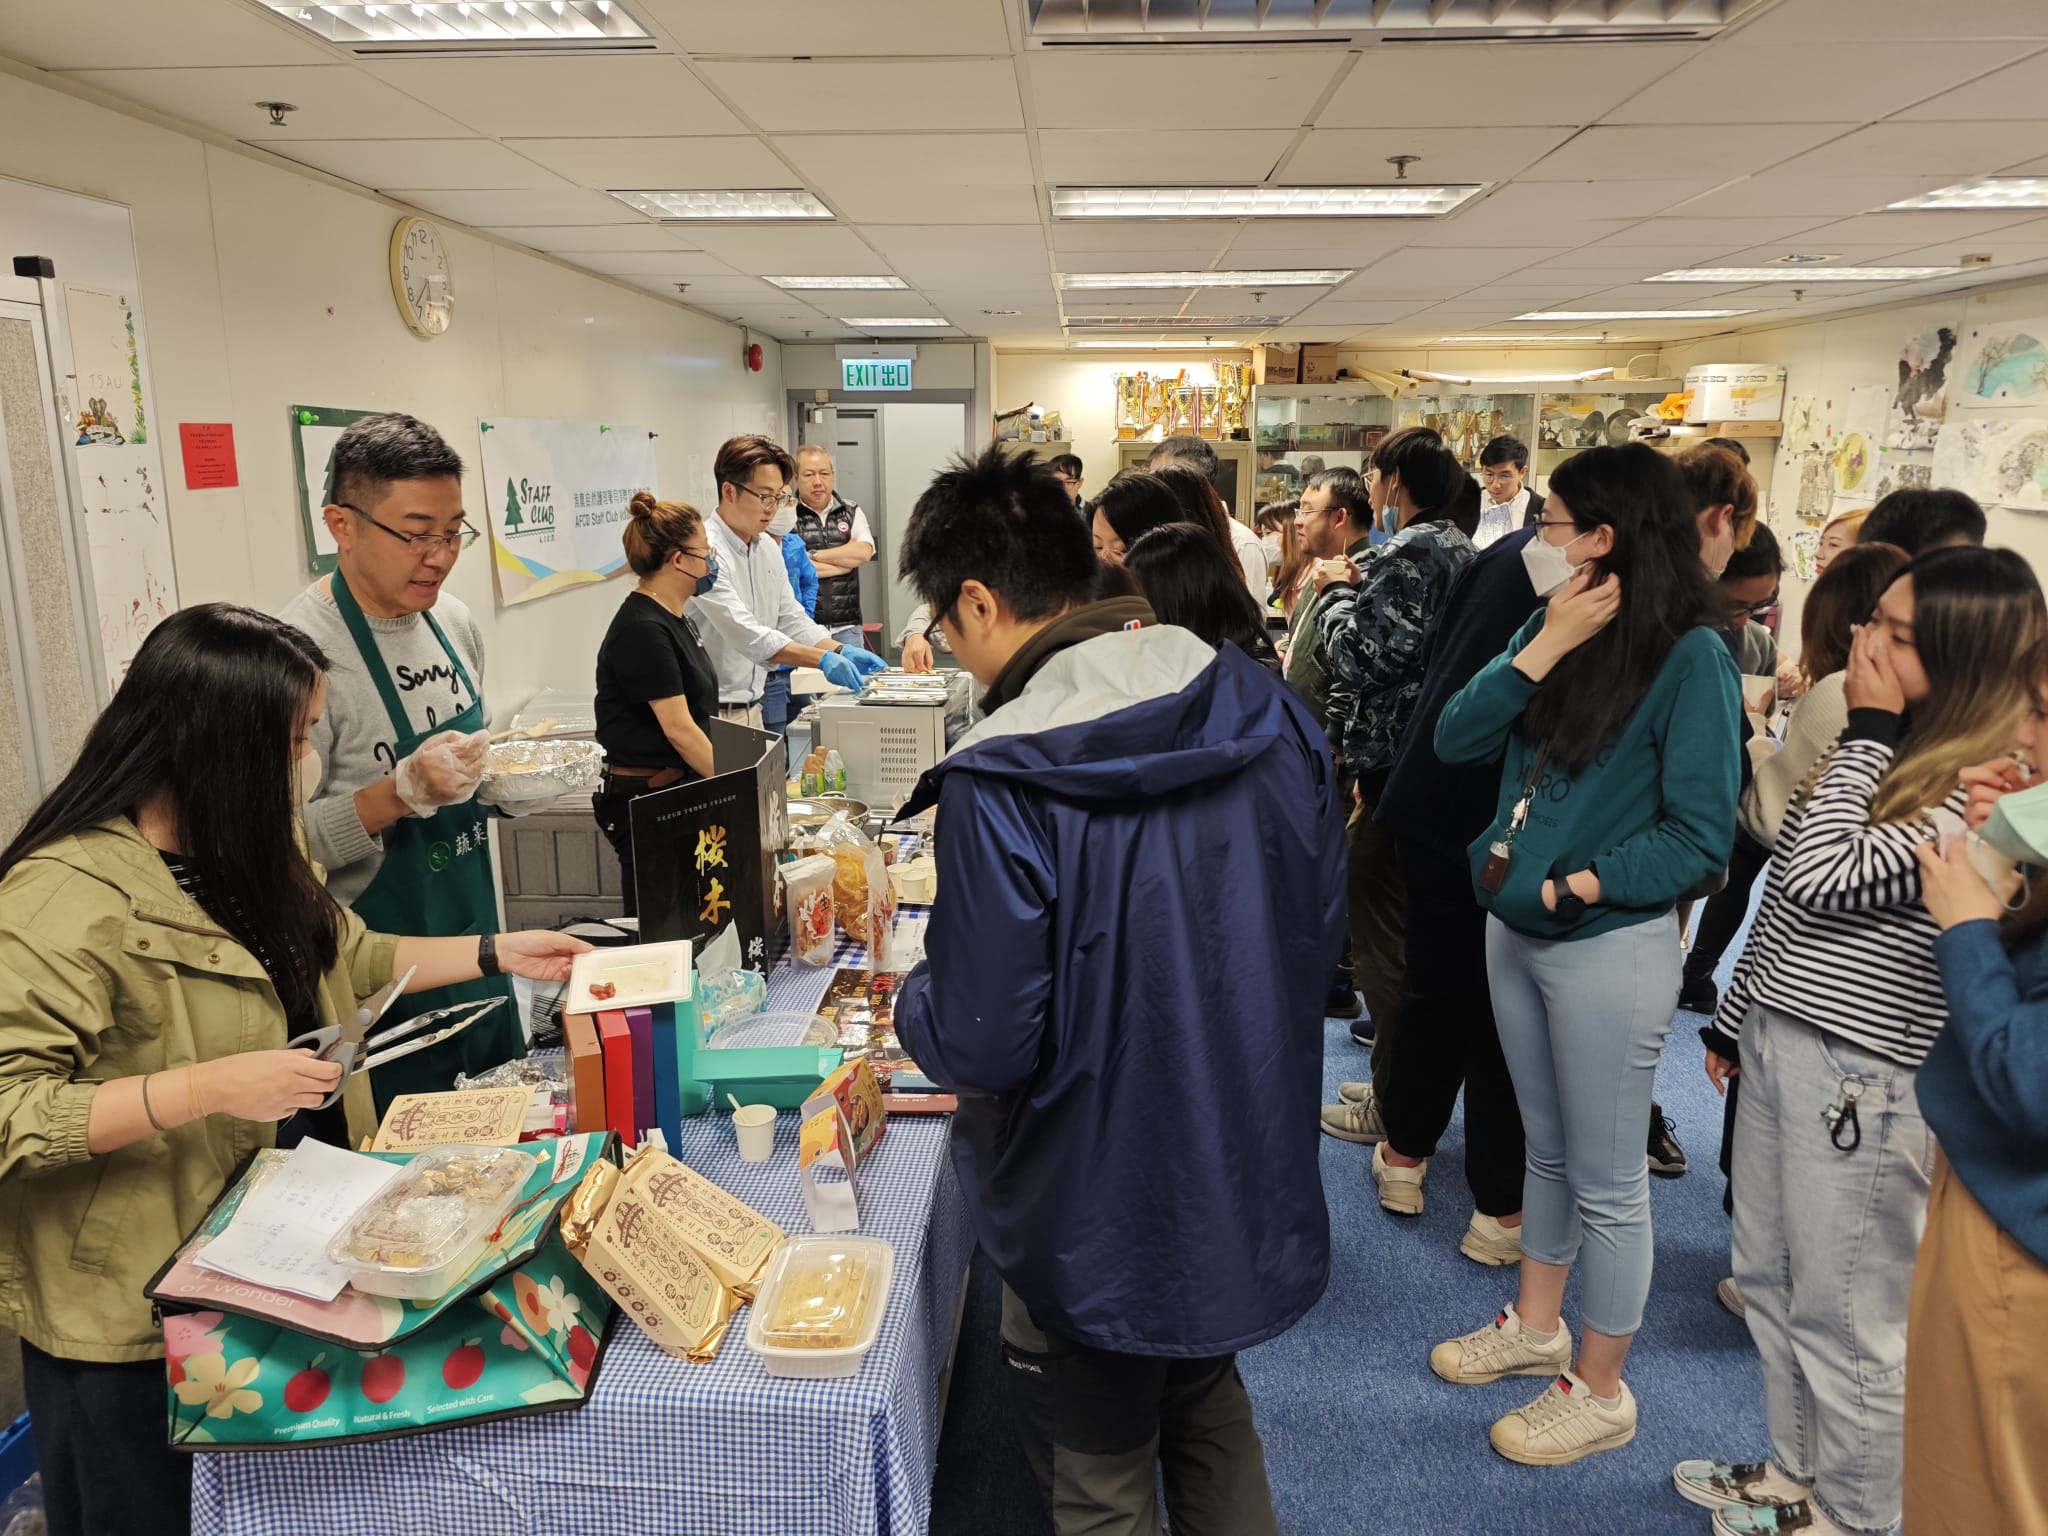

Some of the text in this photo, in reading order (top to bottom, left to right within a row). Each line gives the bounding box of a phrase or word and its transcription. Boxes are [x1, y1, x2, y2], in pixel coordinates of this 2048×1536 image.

[411, 231, 418, 248] 11
[418, 229, 427, 244] 12
[404, 245, 414, 261] 10
[437, 255, 445, 270] 2
[403, 265, 410, 280] 9
[407, 287, 415, 302] 8
[846, 364, 909, 386] EXIT 出口
[520, 477, 551, 505] STAFF
[530, 505, 555, 526] CLUB
[575, 512, 590, 528] AFCD
[591, 510, 605, 526] Staff
[605, 508, 619, 524] Club
[180, 1281, 300, 1309] of wonder
[427, 1393, 495, 1414] Selected with Care
[274, 1416, 341, 1436] Premium Quality
[353, 1410, 411, 1424] Natural & Fresh
